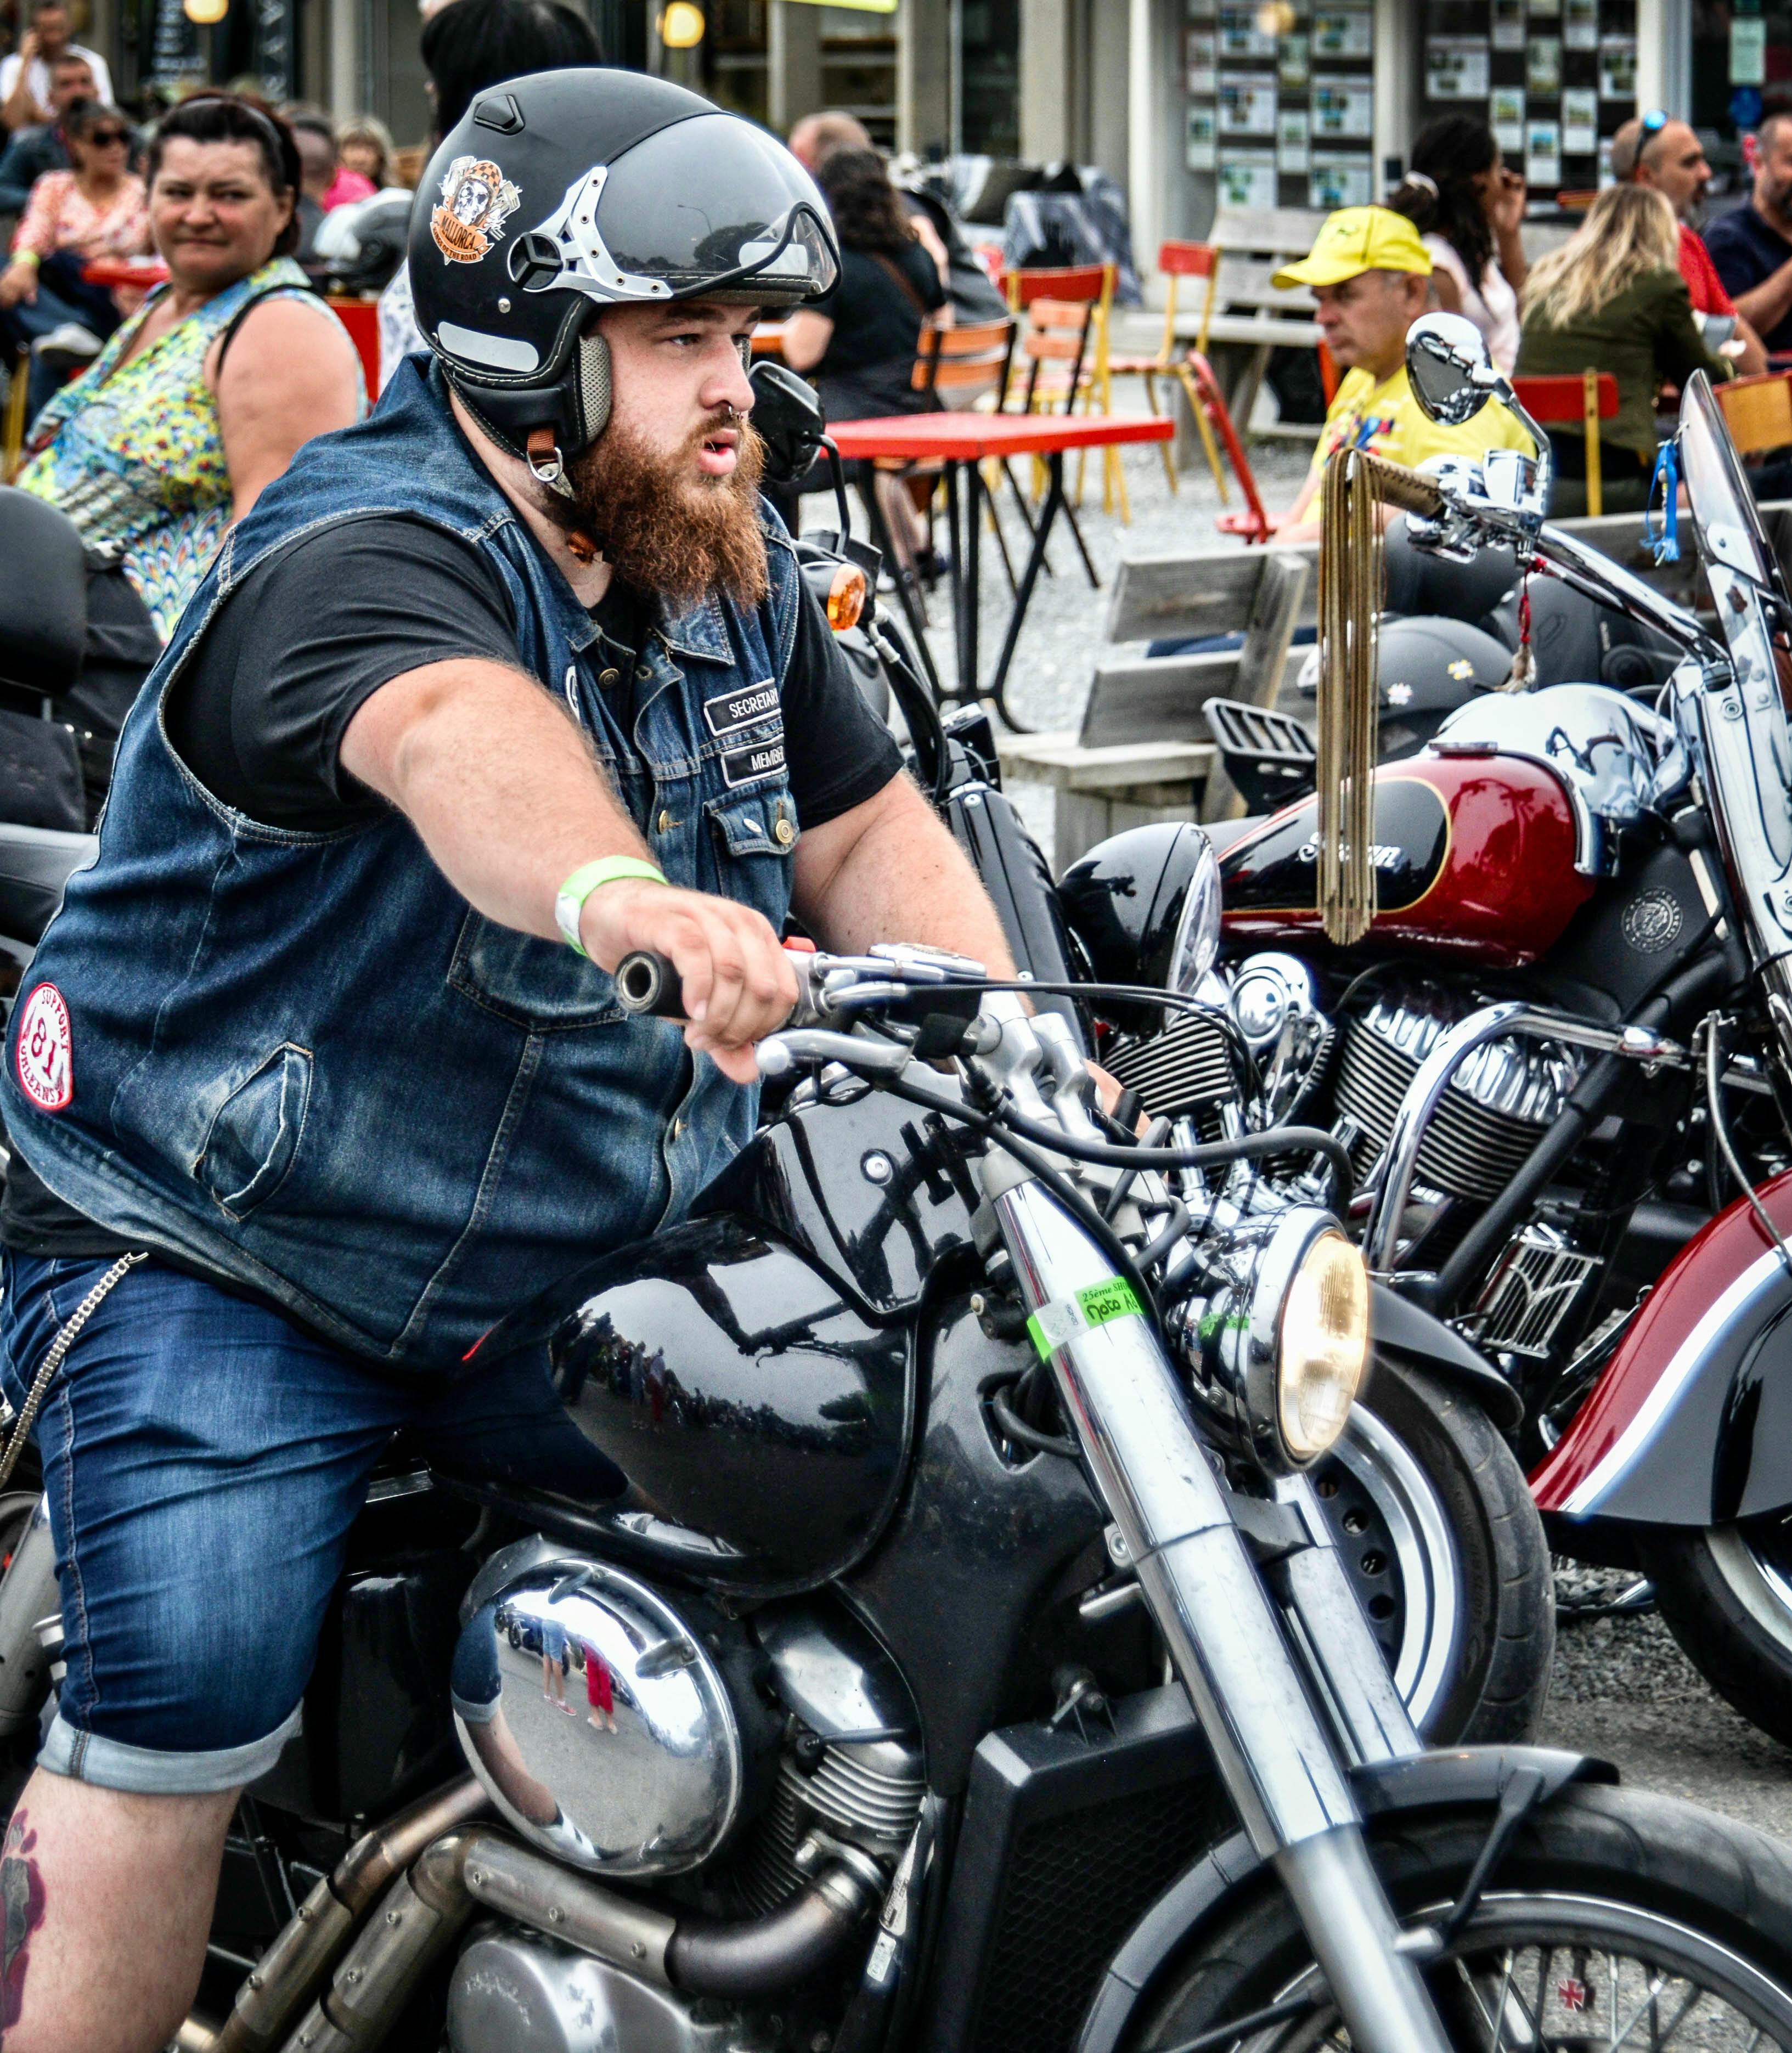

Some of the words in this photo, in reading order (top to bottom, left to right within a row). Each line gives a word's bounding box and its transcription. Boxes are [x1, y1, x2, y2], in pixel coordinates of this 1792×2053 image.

[442, 215, 476, 250] MALLORCA
[449, 250, 460, 260] THE
[41, 989, 69, 1053] SUPPORT
[31, 1017, 57, 1080] 81
[20, 1045, 55, 1103] ORLEANS
[1082, 1287, 1112, 1302] 25ème
